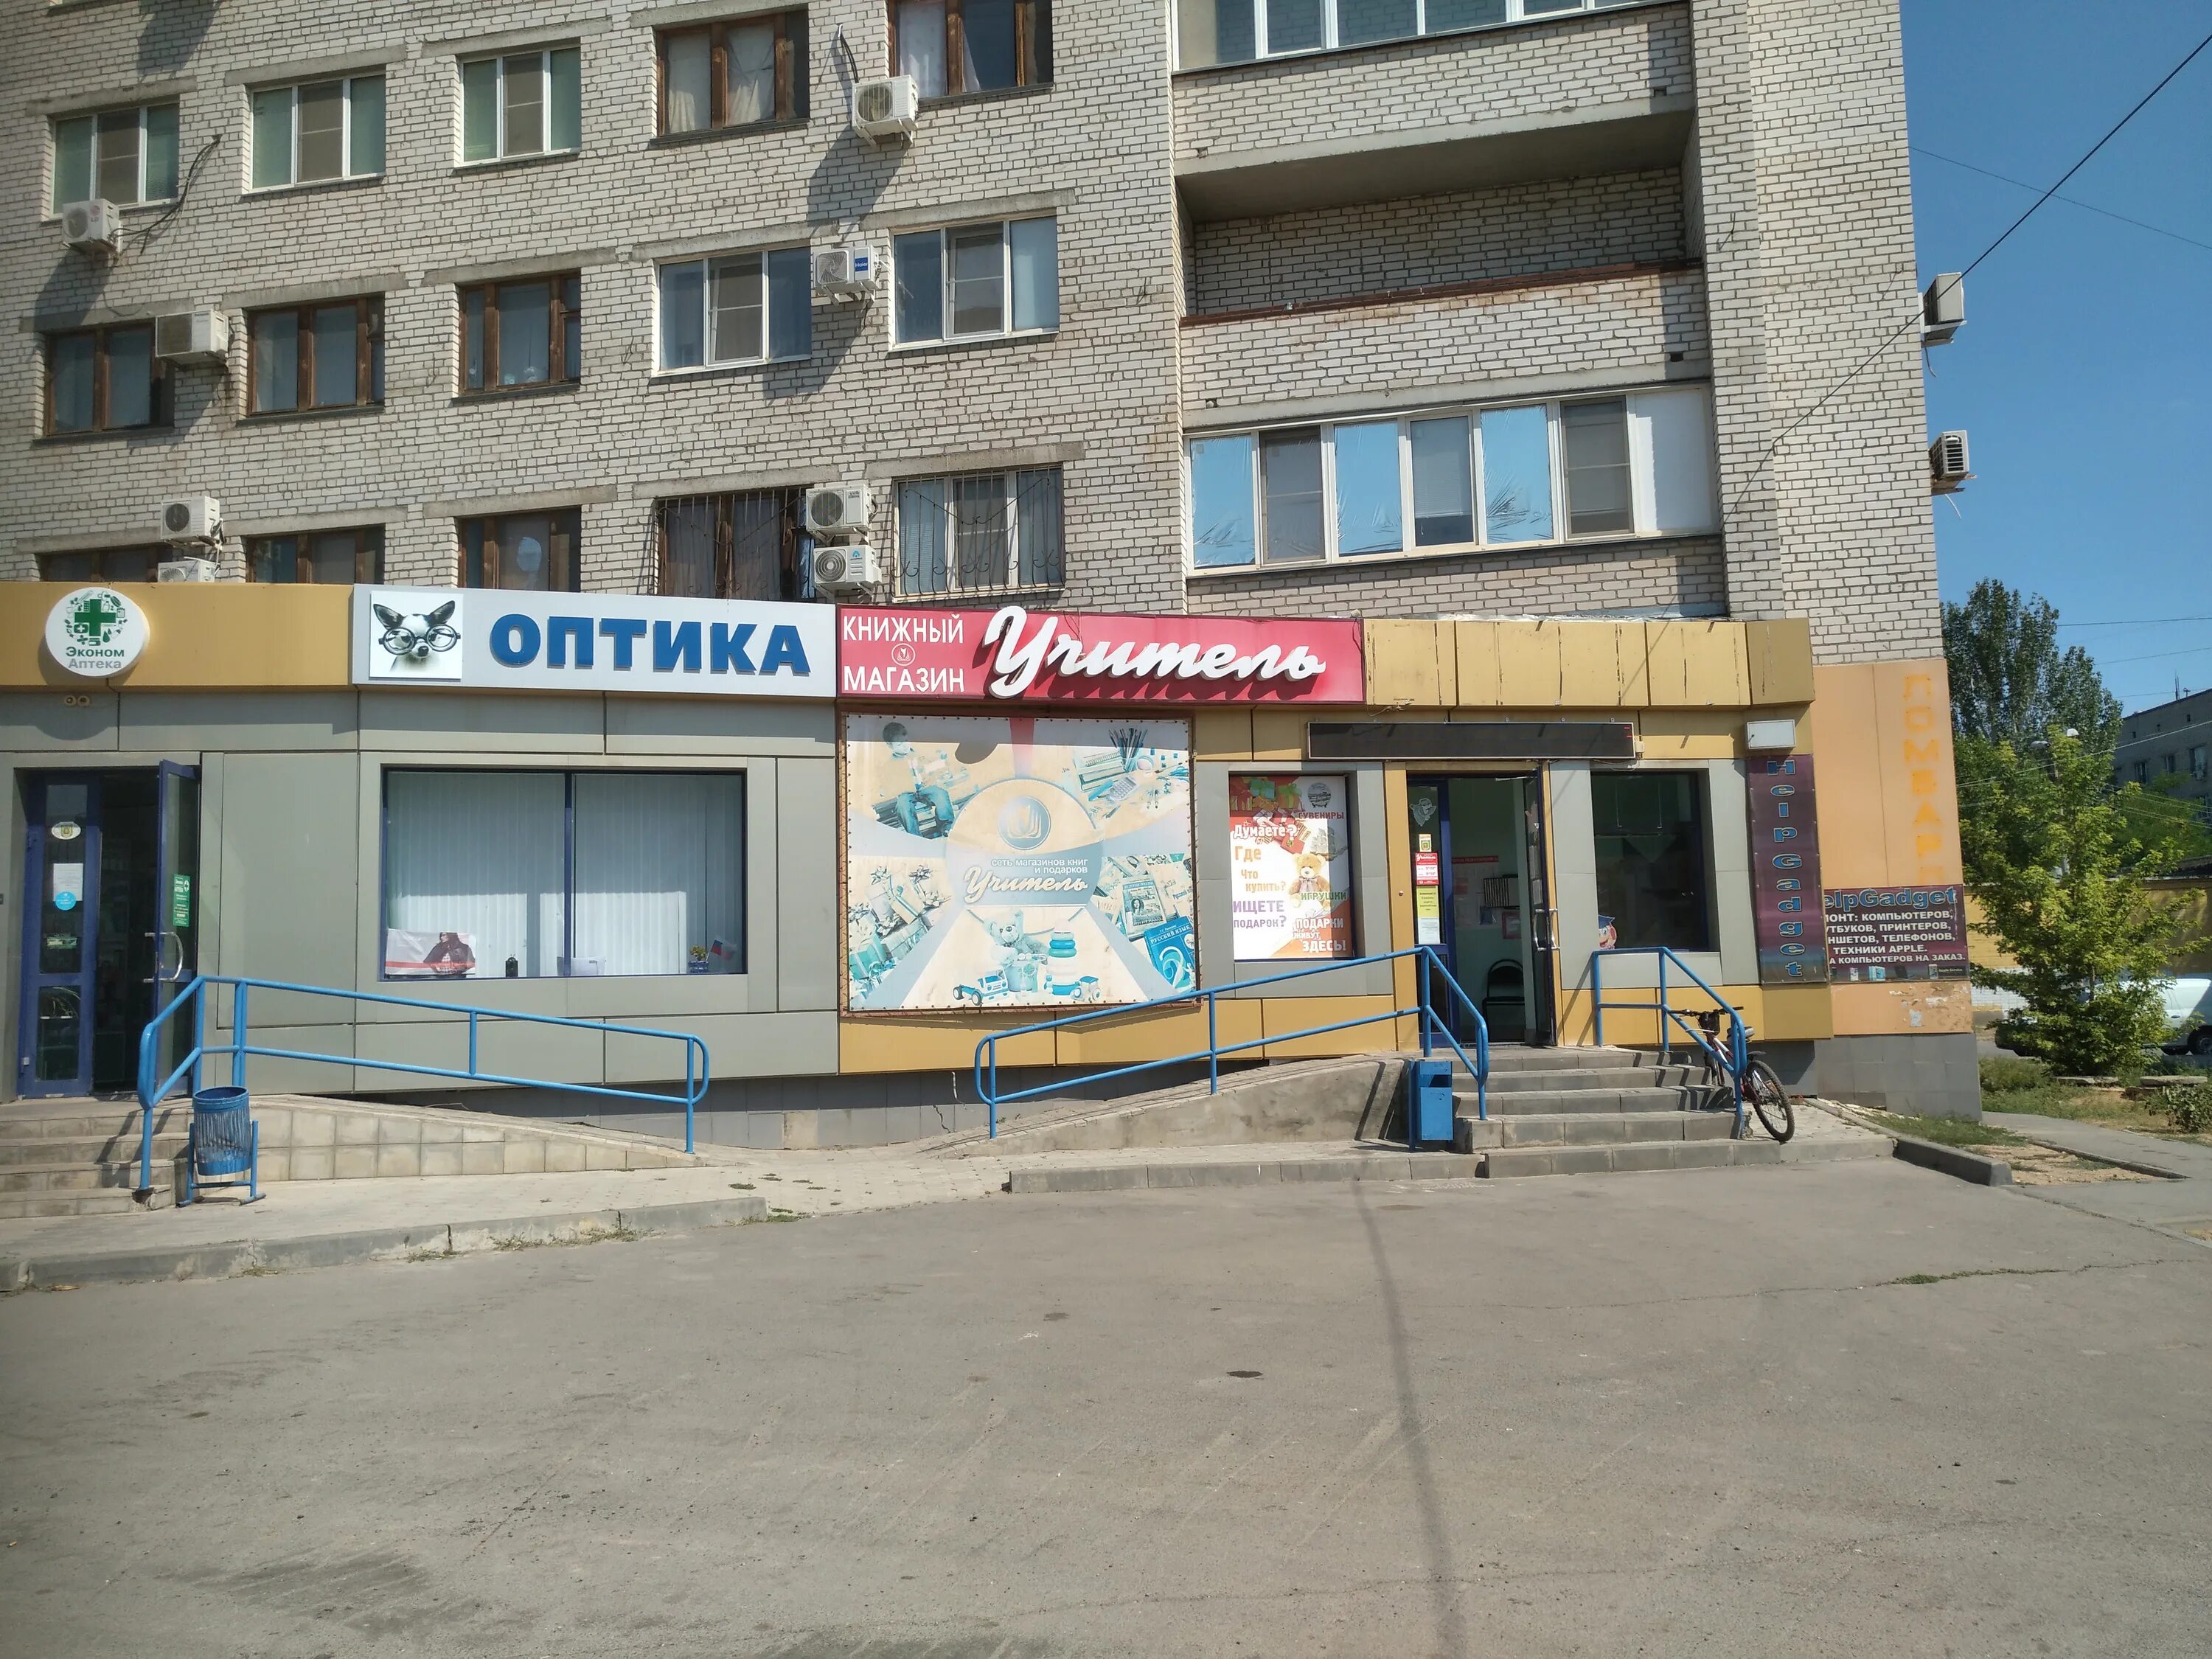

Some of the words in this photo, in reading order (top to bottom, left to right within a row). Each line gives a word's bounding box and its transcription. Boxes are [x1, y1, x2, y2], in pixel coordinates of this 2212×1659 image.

[843, 613, 964, 644] КНИЖНЫЙ
[490, 613, 811, 675] ОПТИКА
[66, 646, 125, 657] Эконом
[983, 605, 1326, 698] Учитель
[68, 658, 122, 669] Аптека
[843, 666, 964, 693] МАГАЗИН
[1298, 812, 1345, 820] СУВЕНИРЫ
[1234, 846, 1262, 862] Где
[1043, 866, 1088, 874] подарков
[1241, 869, 1259, 879] Что
[964, 866, 1088, 903] Учитель
[1245, 881, 1286, 893] купить?
[1301, 891, 1346, 900] ИГРУШКИ
[1233, 900, 1284, 914] ИЩЕТЕ
[1862, 911, 1953, 922] КОМПЬЮТЕРОВ,
[1295, 918, 1343, 930] ПОДАРКИ
[1879, 922, 1951, 931] ПРИНТЕРОВ,
[1150, 930, 1175, 945] РУССКИЙ
[1882, 933, 1955, 943] ТЕЛЕФОНОВ,
[1302, 940, 1346, 953] ЗДЕСЬ!
[1833, 947, 1885, 955] ТЕХНИКИ
[1889, 945, 1927, 953] APPLE.
[1838, 955, 1913, 964] КОМПЬЮТЕРОВ
[1932, 953, 1966, 961] ЗАКАЗ.
